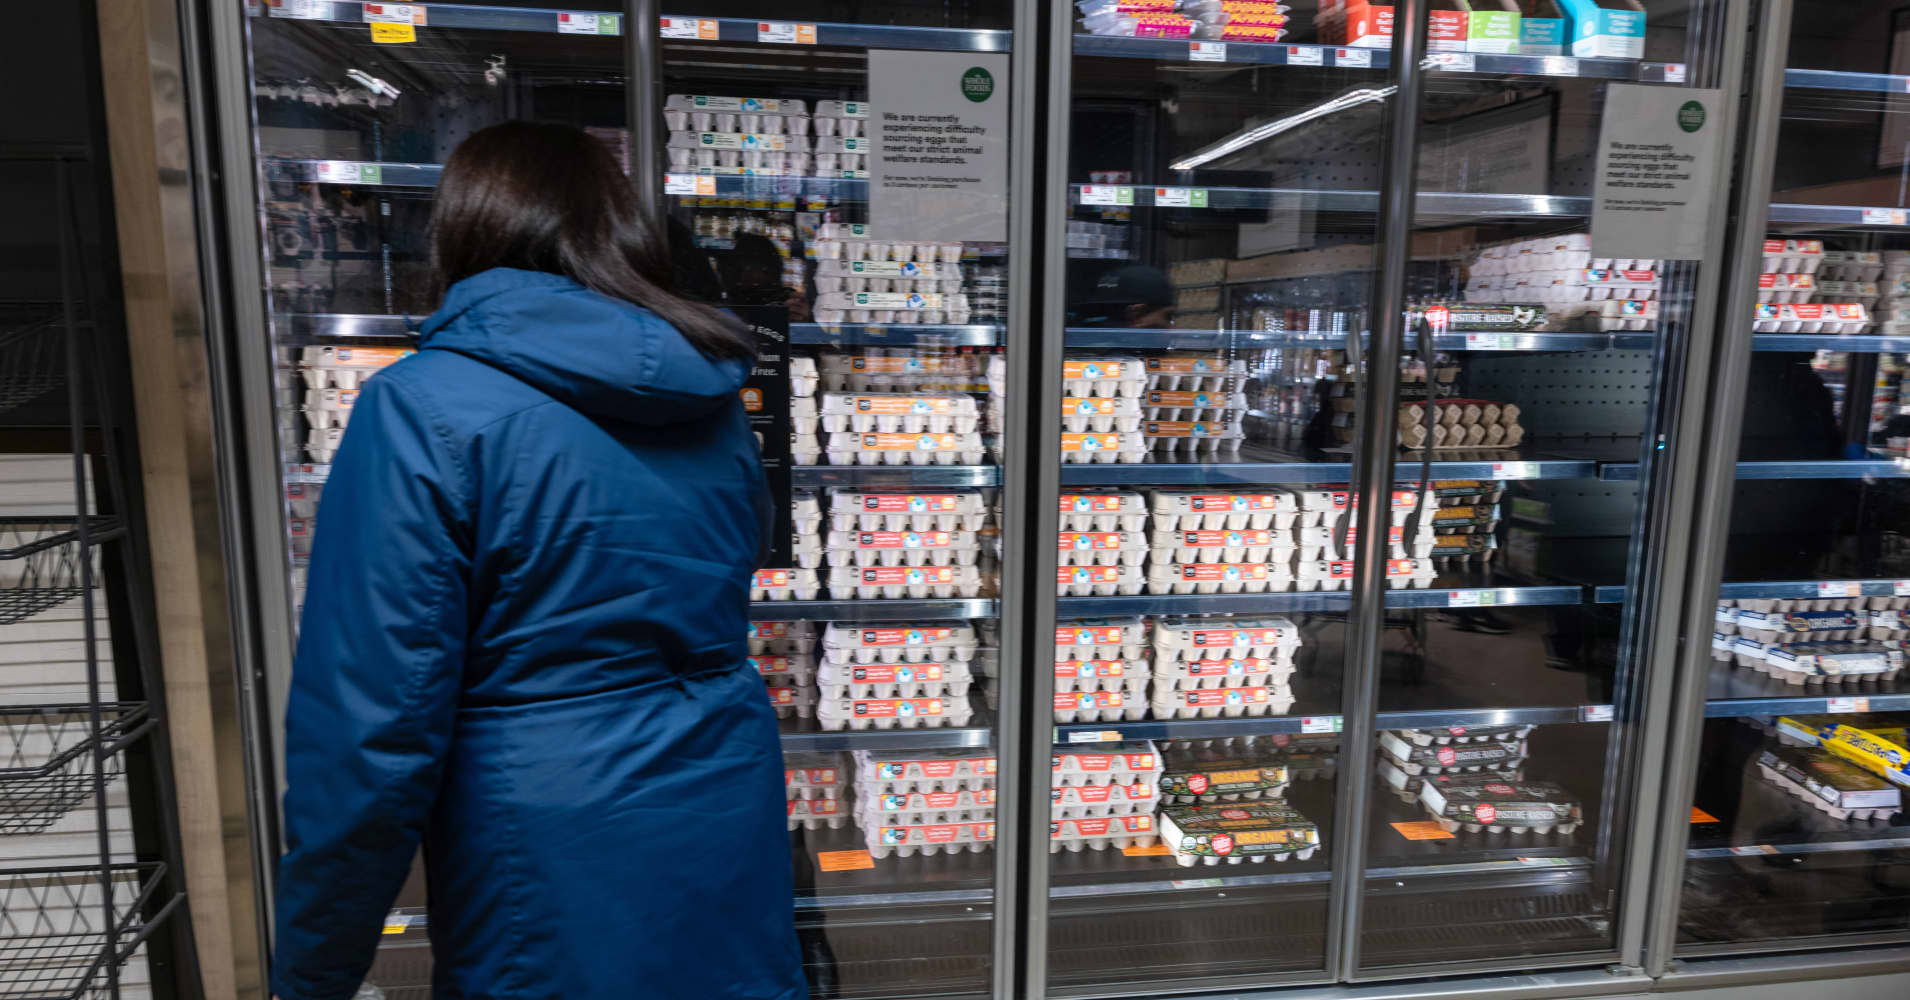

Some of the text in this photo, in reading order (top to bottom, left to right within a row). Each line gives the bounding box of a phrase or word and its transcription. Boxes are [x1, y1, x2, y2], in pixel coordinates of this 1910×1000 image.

[883, 112, 960, 124] We are currently
[883, 123, 986, 136] experiencing difficulty
[883, 134, 968, 145] sourcing eggs that
[883, 144, 907, 152] meet
[926, 145, 952, 154] strict
[952, 145, 984, 155] animal
[883, 154, 968, 165] welfare standards.
[756, 326, 786, 342] EGGS
[1210, 769, 1260, 784] ORGANIC
[1235, 829, 1288, 845] ORGANIC
